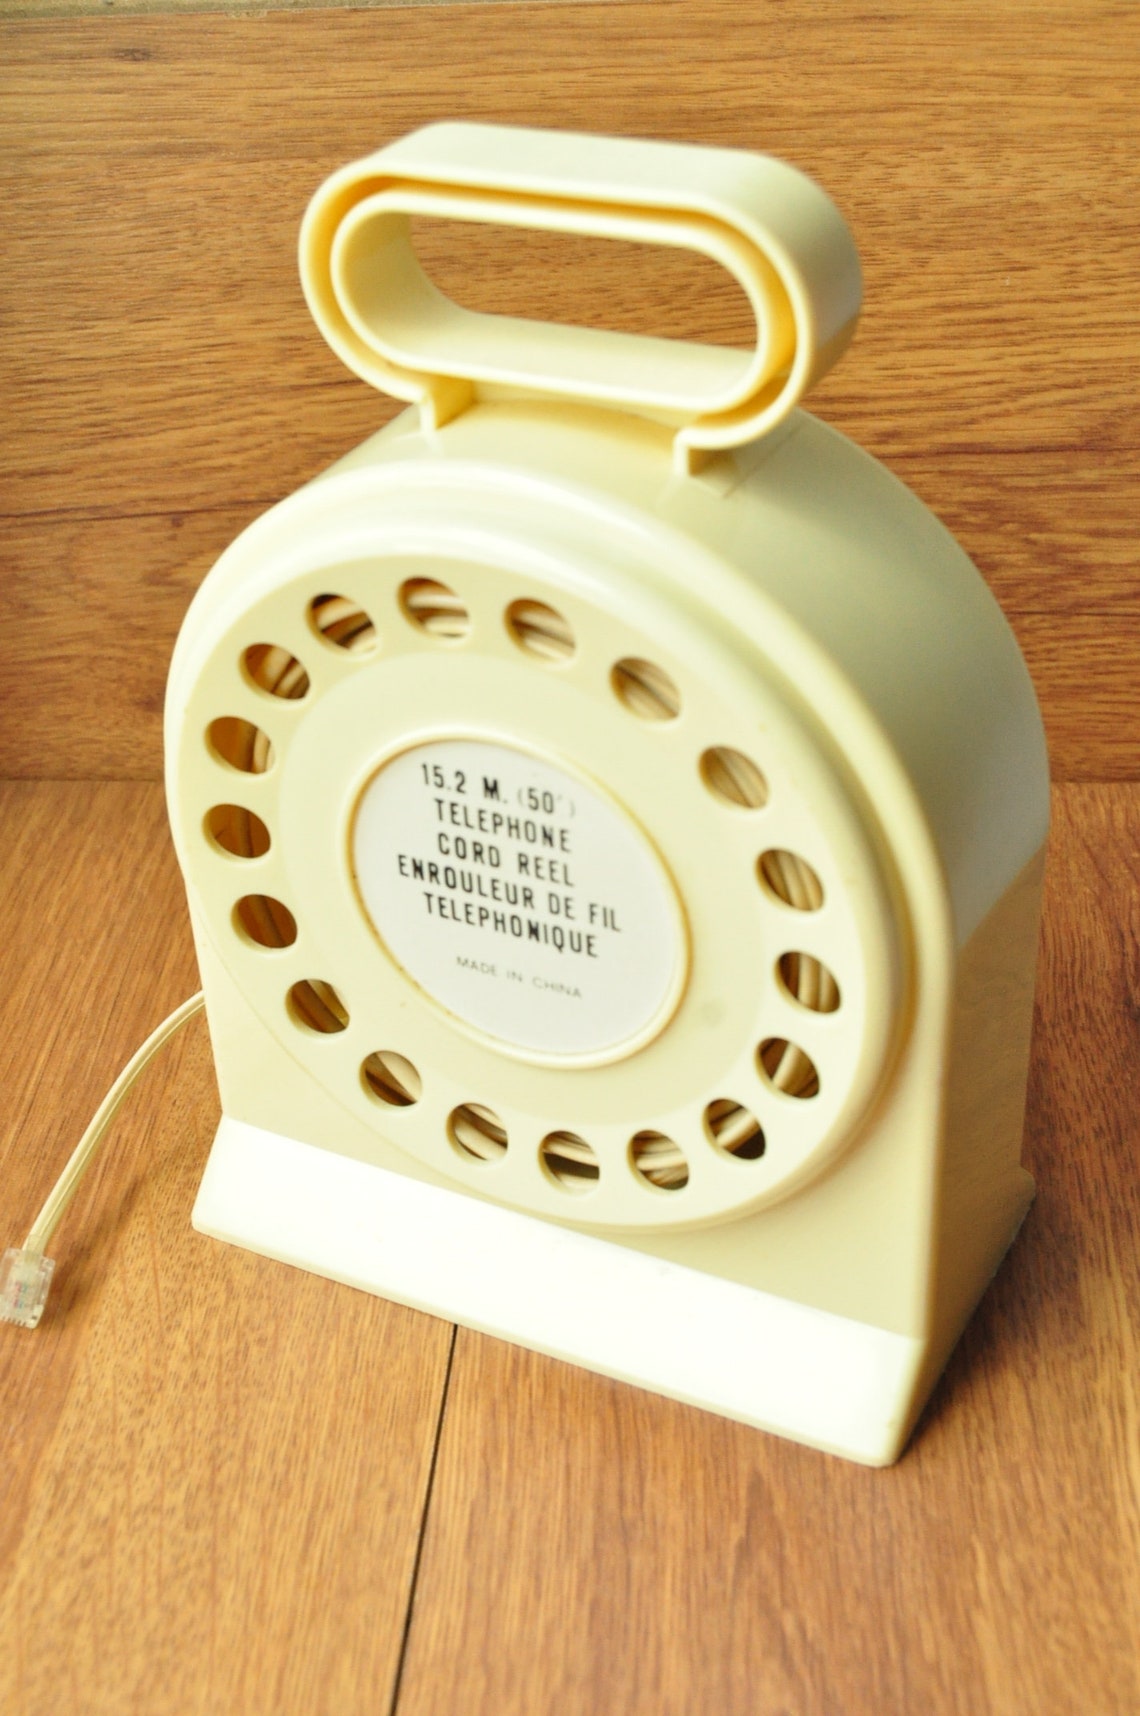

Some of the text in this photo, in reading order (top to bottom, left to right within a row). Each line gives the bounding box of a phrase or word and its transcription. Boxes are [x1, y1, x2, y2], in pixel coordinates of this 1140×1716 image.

[421, 762, 467, 795] 15.2
[481, 775, 509, 804] M.
[434, 797, 572, 853] TELEPHONE
[438, 831, 575, 888] CORD REEL
[397, 853, 622, 933] ENROULEUR DE FIL
[423, 891, 599, 959] TELEPHONIQUE
[455, 955, 583, 999] MADE IN CHINA
